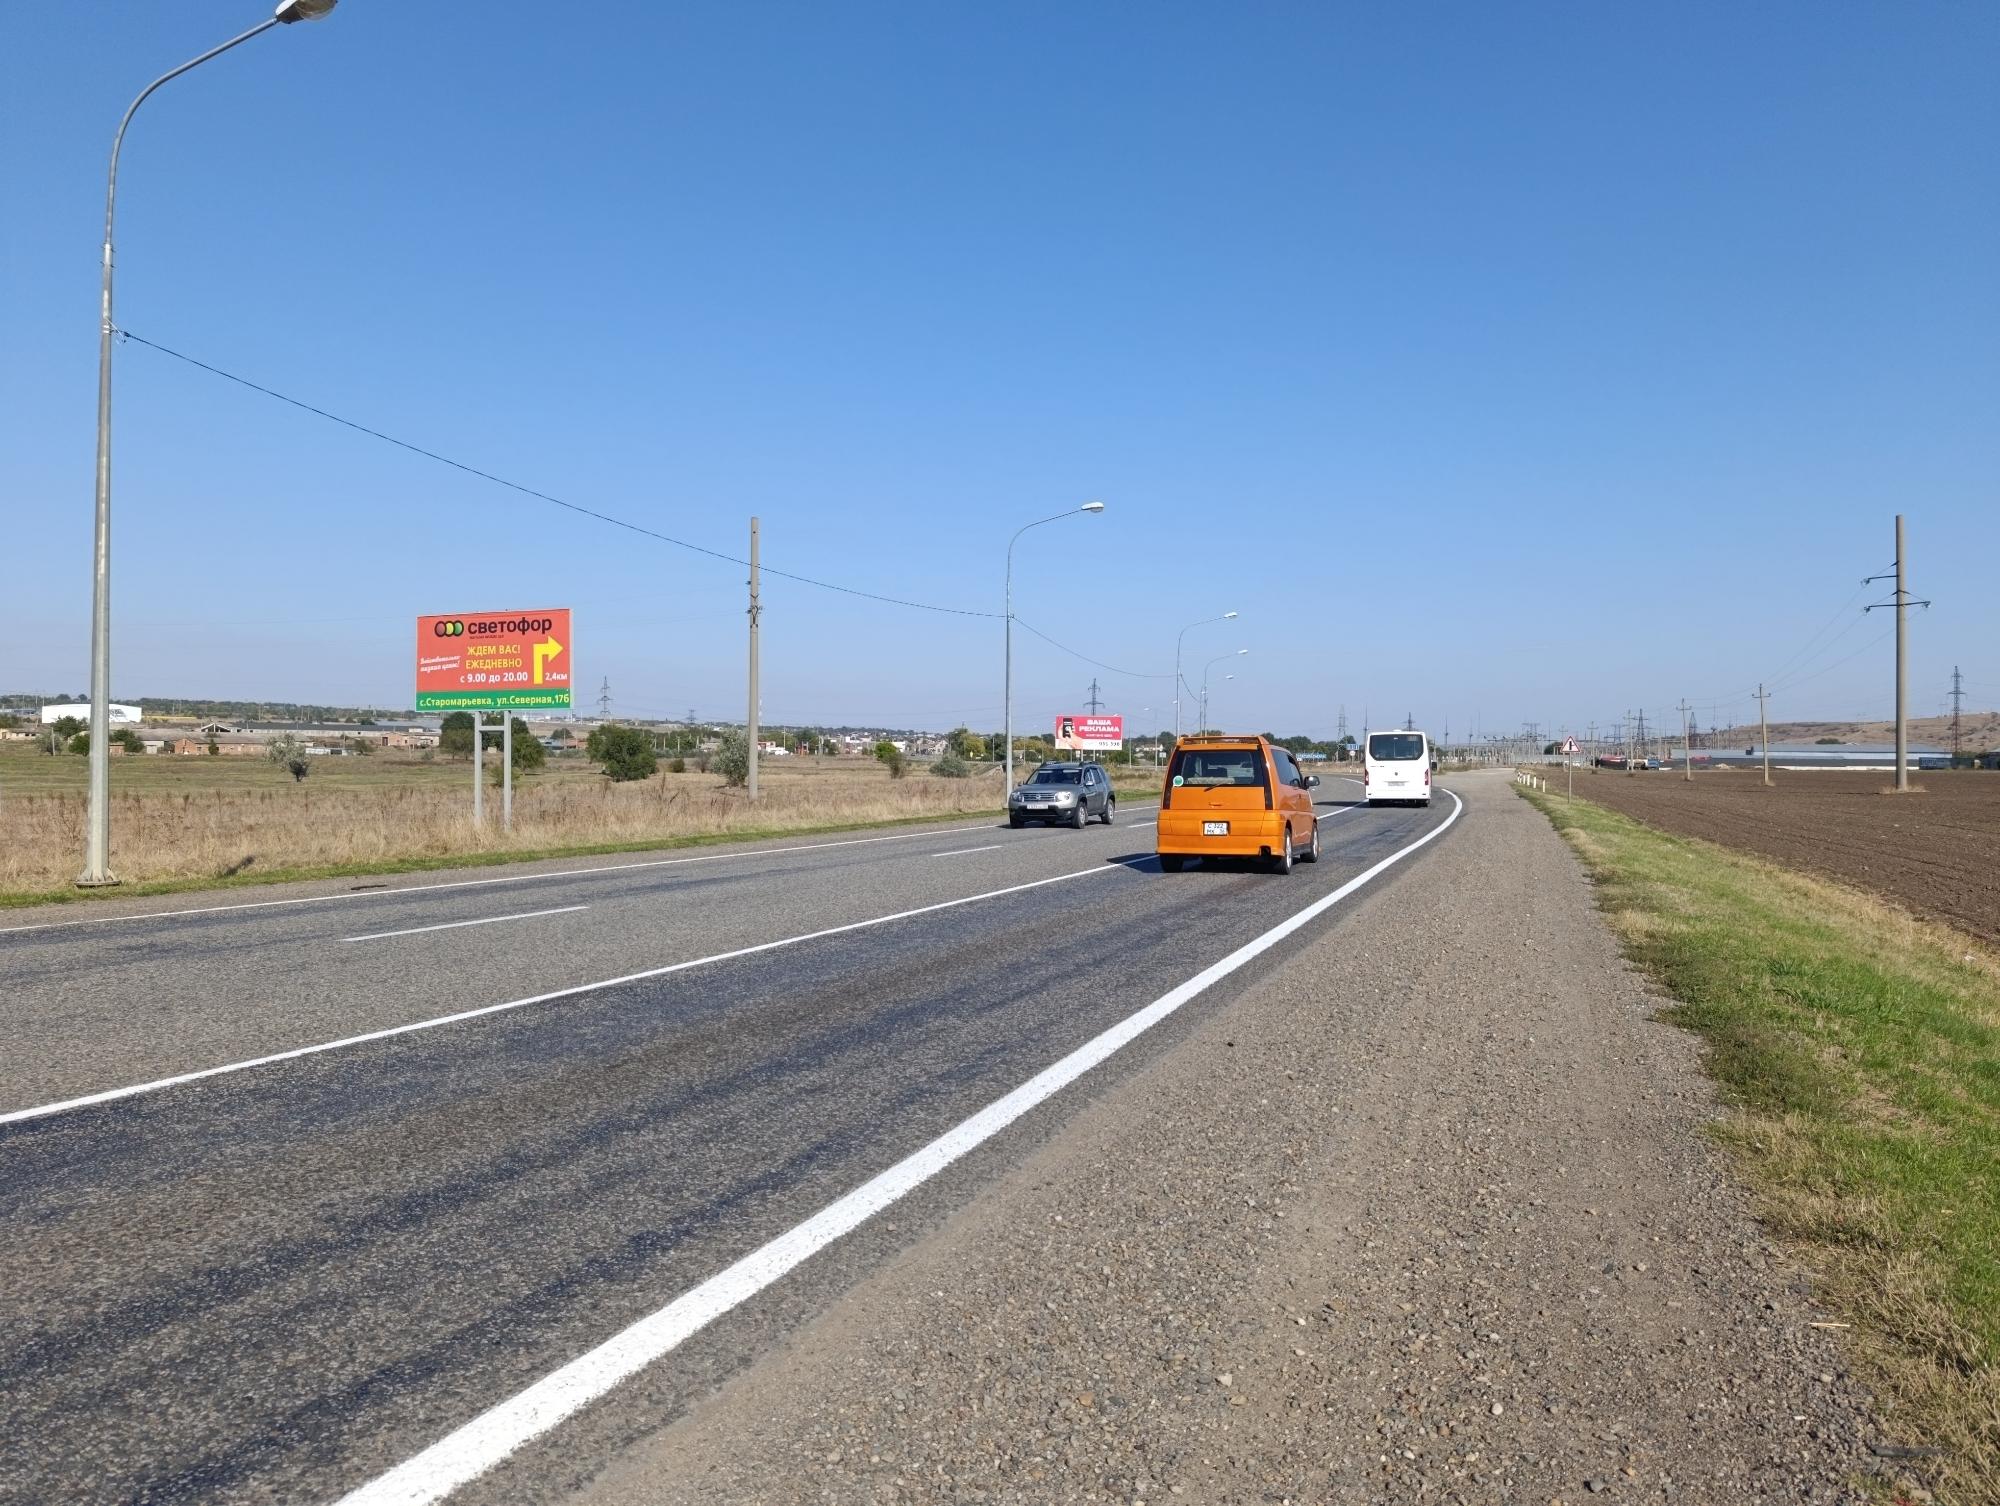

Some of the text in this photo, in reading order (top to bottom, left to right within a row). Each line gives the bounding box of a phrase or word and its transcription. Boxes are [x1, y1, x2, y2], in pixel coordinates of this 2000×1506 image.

[468, 617, 552, 635] светофор
[467, 644, 521, 656] ЖДЕМ ВАС!
[465, 658, 522, 670] ЕЖЕДНЕВНО
[467, 673, 486, 683] 9.00
[488, 674, 501, 684] до
[503, 671, 528, 682] 20.00
[545, 672, 568, 682] 2,4км
